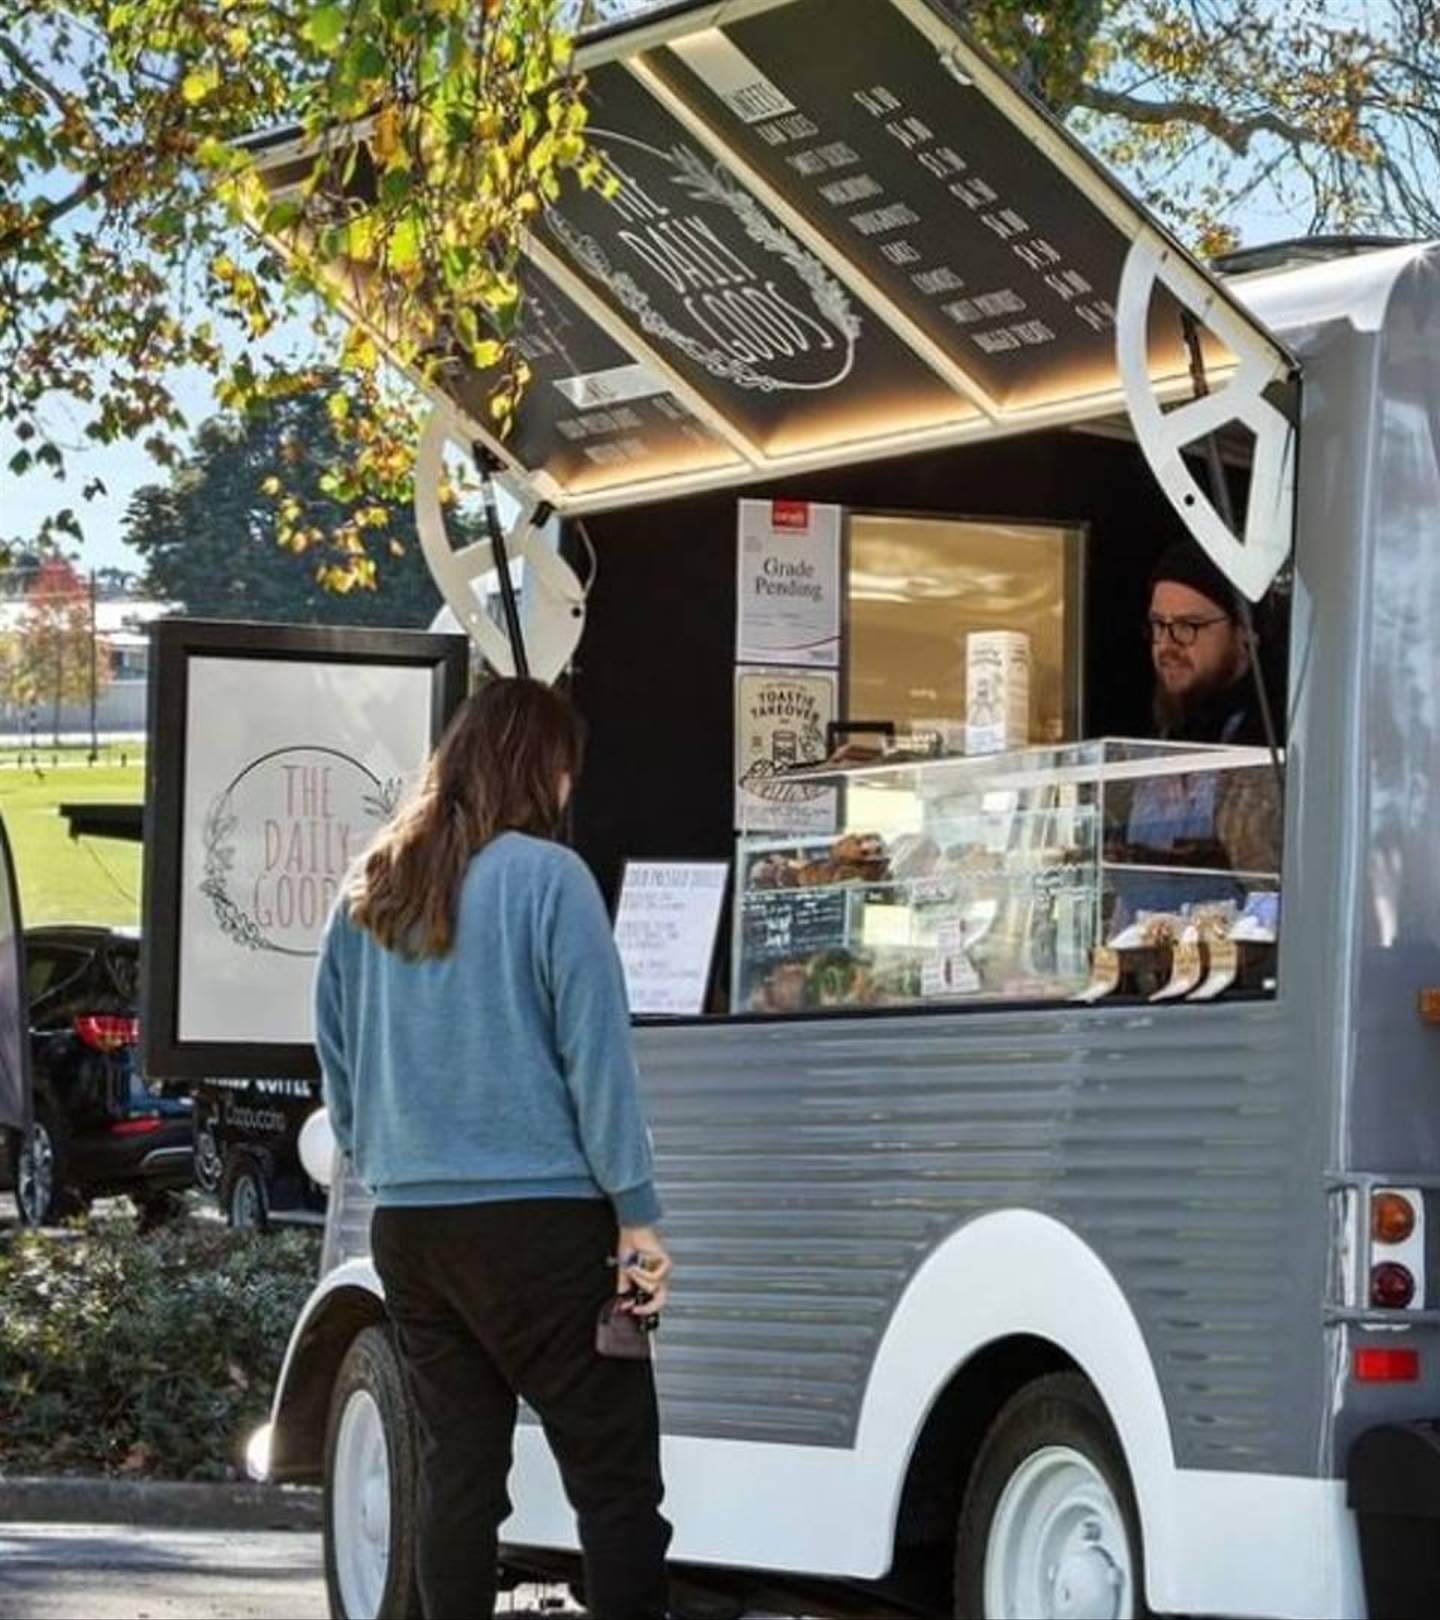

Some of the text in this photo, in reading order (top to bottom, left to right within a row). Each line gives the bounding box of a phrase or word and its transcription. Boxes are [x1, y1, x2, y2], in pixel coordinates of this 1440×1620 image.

[616, 215, 757, 294] DAILY
[683, 281, 835, 364] GOODS
[755, 575, 823, 603] Pending
[763, 556, 816, 578] Grade
[750, 703, 821, 723] TAKEOVER
[758, 689, 816, 708] TOASTIE
[282, 765, 336, 818] THE
[264, 819, 349, 874] DAILY
[255, 874, 338, 929] GOOD
